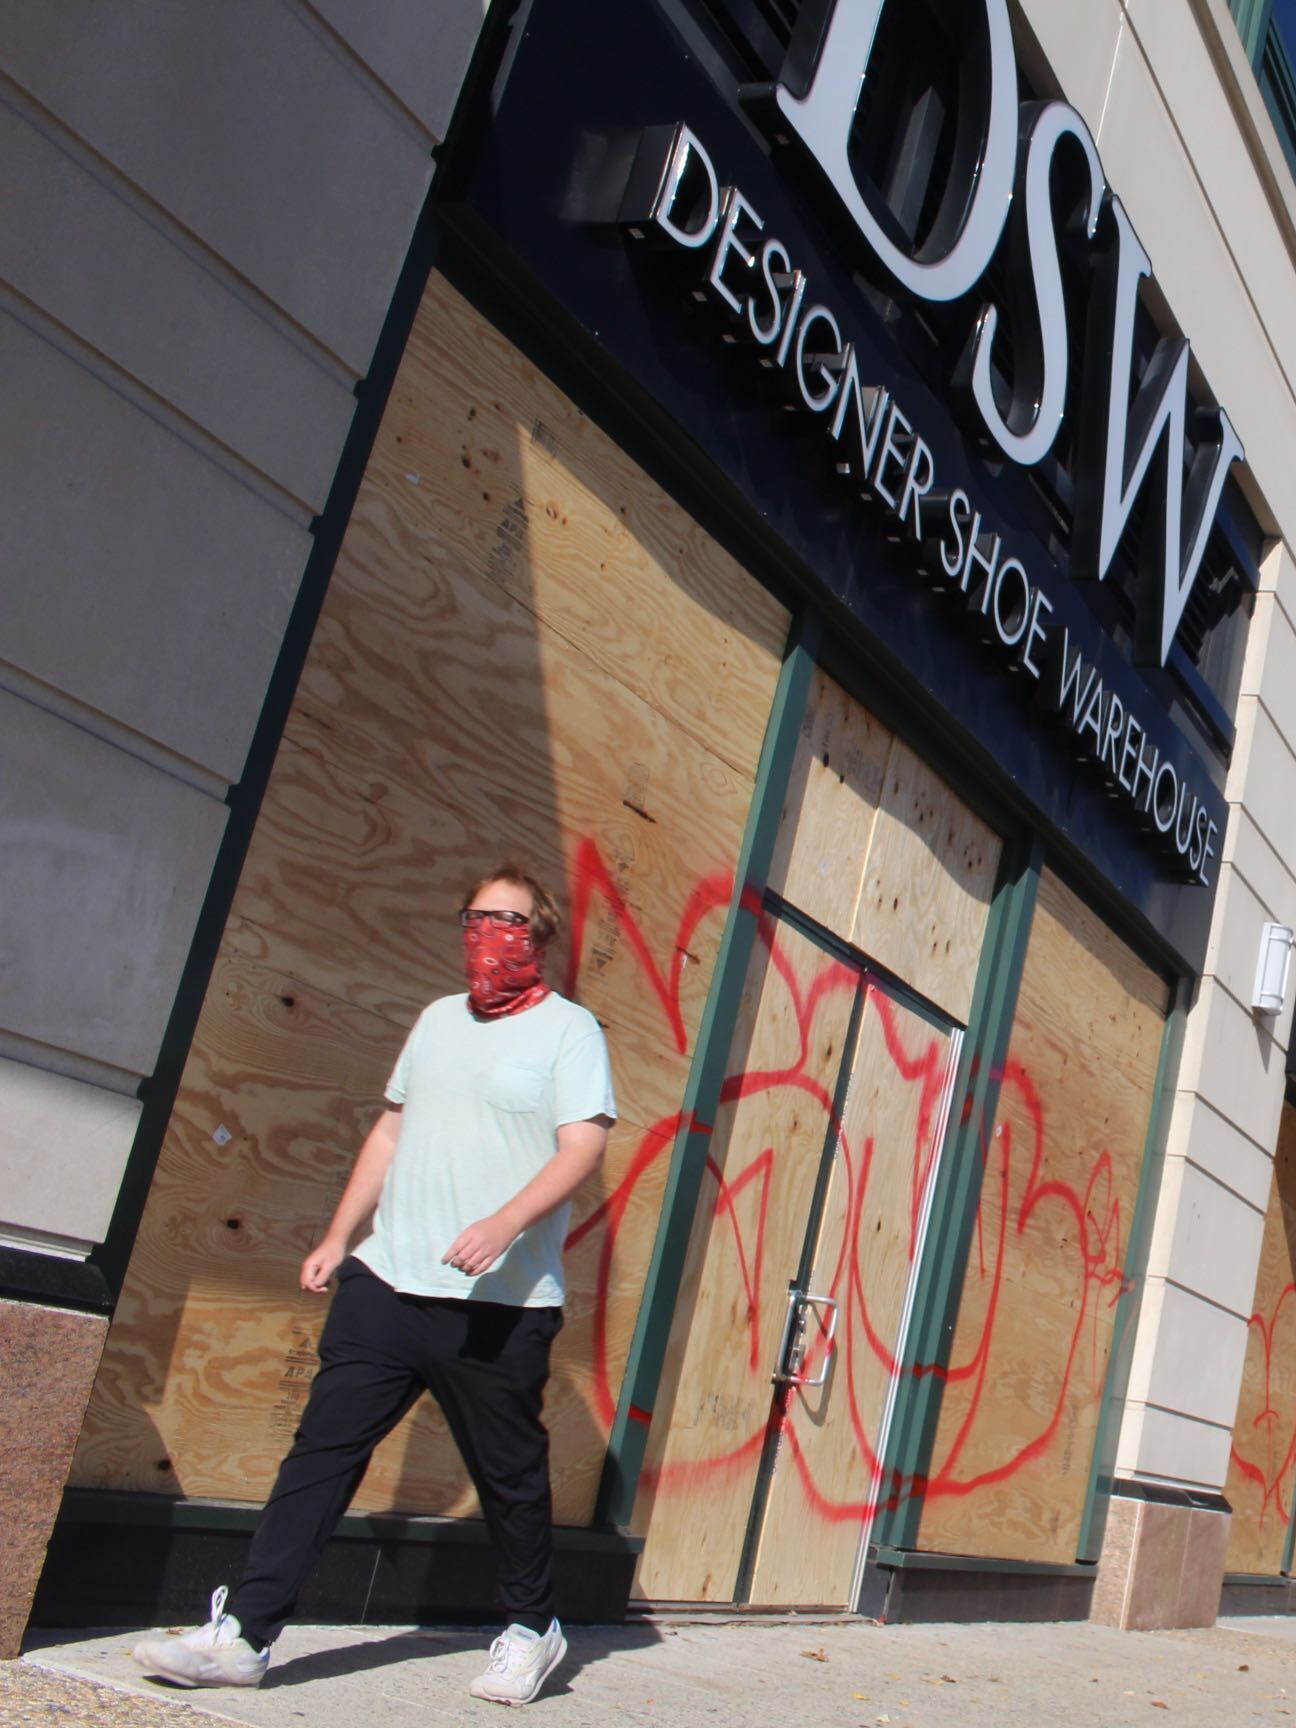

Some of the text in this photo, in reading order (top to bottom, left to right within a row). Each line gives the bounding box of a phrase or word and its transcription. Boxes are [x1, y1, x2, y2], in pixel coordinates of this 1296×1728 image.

[654, 121, 1219, 887] DESIGNER SHOE WAREHOUSE
